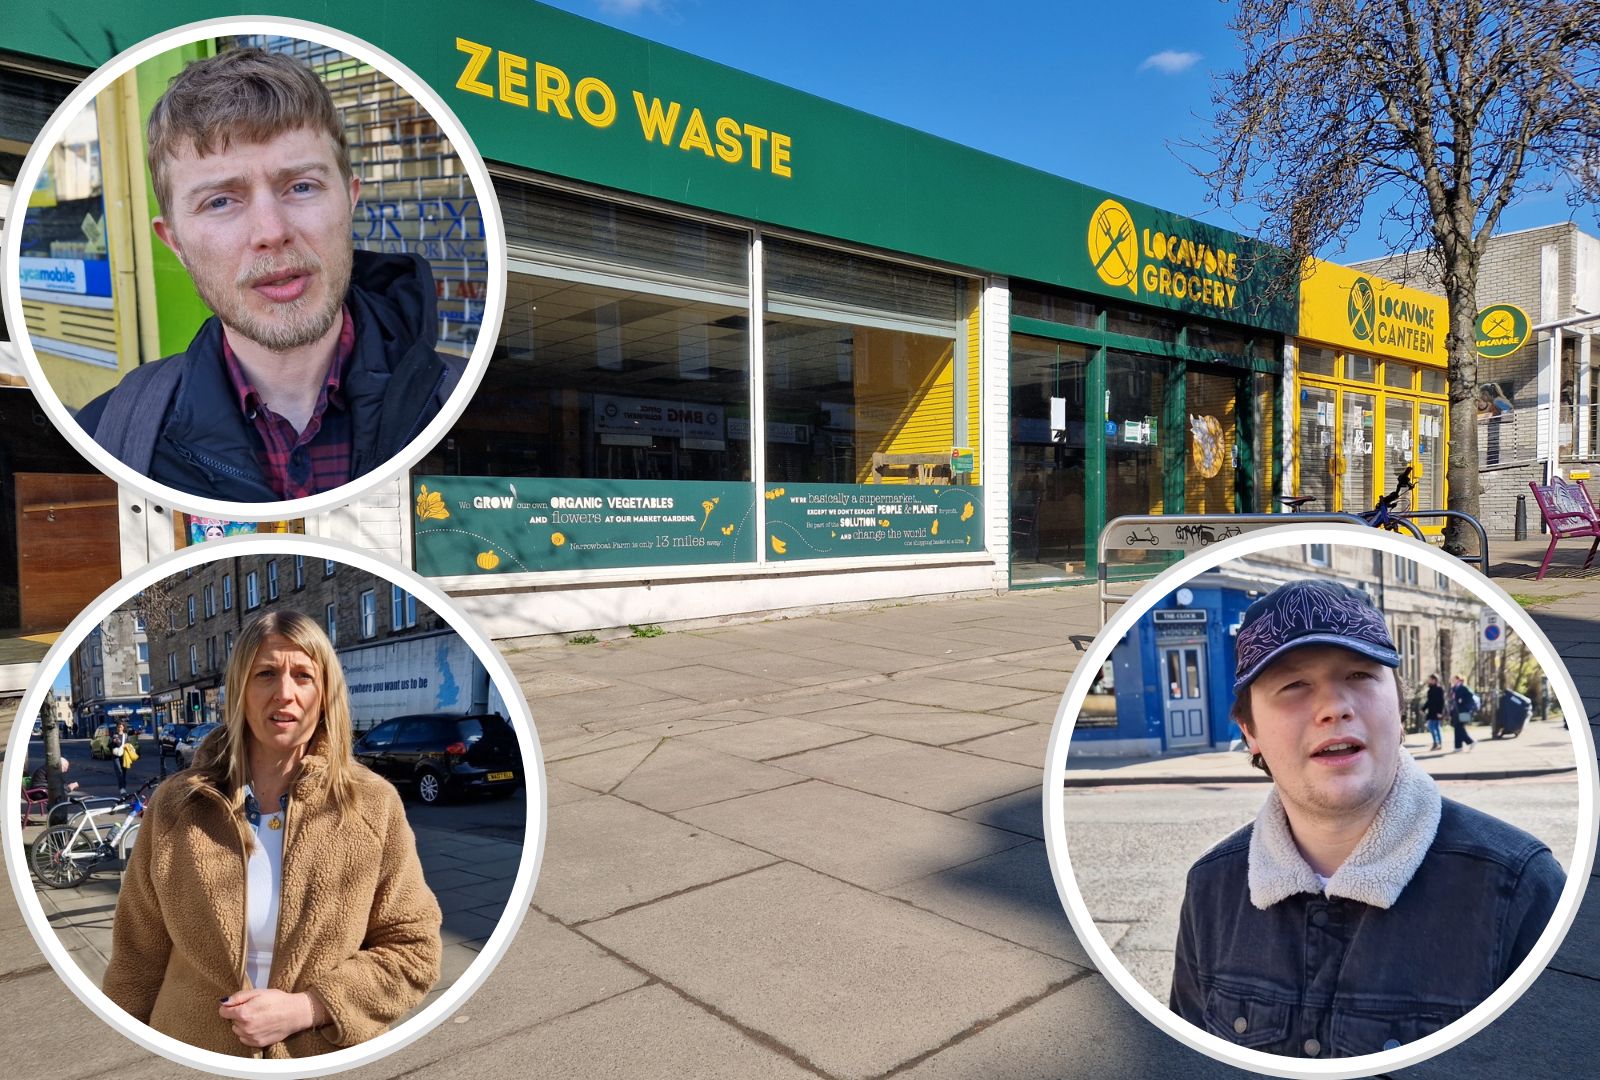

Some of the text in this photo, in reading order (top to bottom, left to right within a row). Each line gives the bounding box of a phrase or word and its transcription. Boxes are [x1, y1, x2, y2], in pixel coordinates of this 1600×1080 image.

[455, 37, 792, 178] ZERO WASTE
[1143, 228, 1237, 280] LOCAVORE
[1143, 264, 1237, 308] GROCERY
[1378, 295, 1434, 330] LOCAVORE
[1378, 322, 1434, 354] CANTEEN
[1476, 337, 1520, 347] LOCAVORE
[473, 496, 514, 509] GROW
[550, 497, 603, 509] ORGANIC
[607, 497, 674, 509] VEGETABLES
[808, 493, 849, 505] basically
[877, 504, 903, 514] PEOPLE
[912, 504, 938, 514] PLANET
[529, 516, 548, 524] AND
[551, 510, 602, 524] flowers
[605, 515, 614, 523] AT
[615, 515, 631, 523] OUR
[633, 515, 661, 523] MARKET
[840, 517, 876, 527] SOLUTION
[853, 528, 885, 541] change
[887, 528, 901, 539] the
[903, 527, 927, 538] world
[570, 542, 611, 550] Narrowboat
[612, 541, 631, 549] Farm
[639, 541, 653, 550] only
[656, 535, 670, 547] 13
[673, 535, 705, 547] miles
[373, 682, 384, 693] you
[385, 680, 400, 691] want
[401, 679, 409, 690] us
[410, 678, 418, 689] to
[418, 677, 428, 688] be
